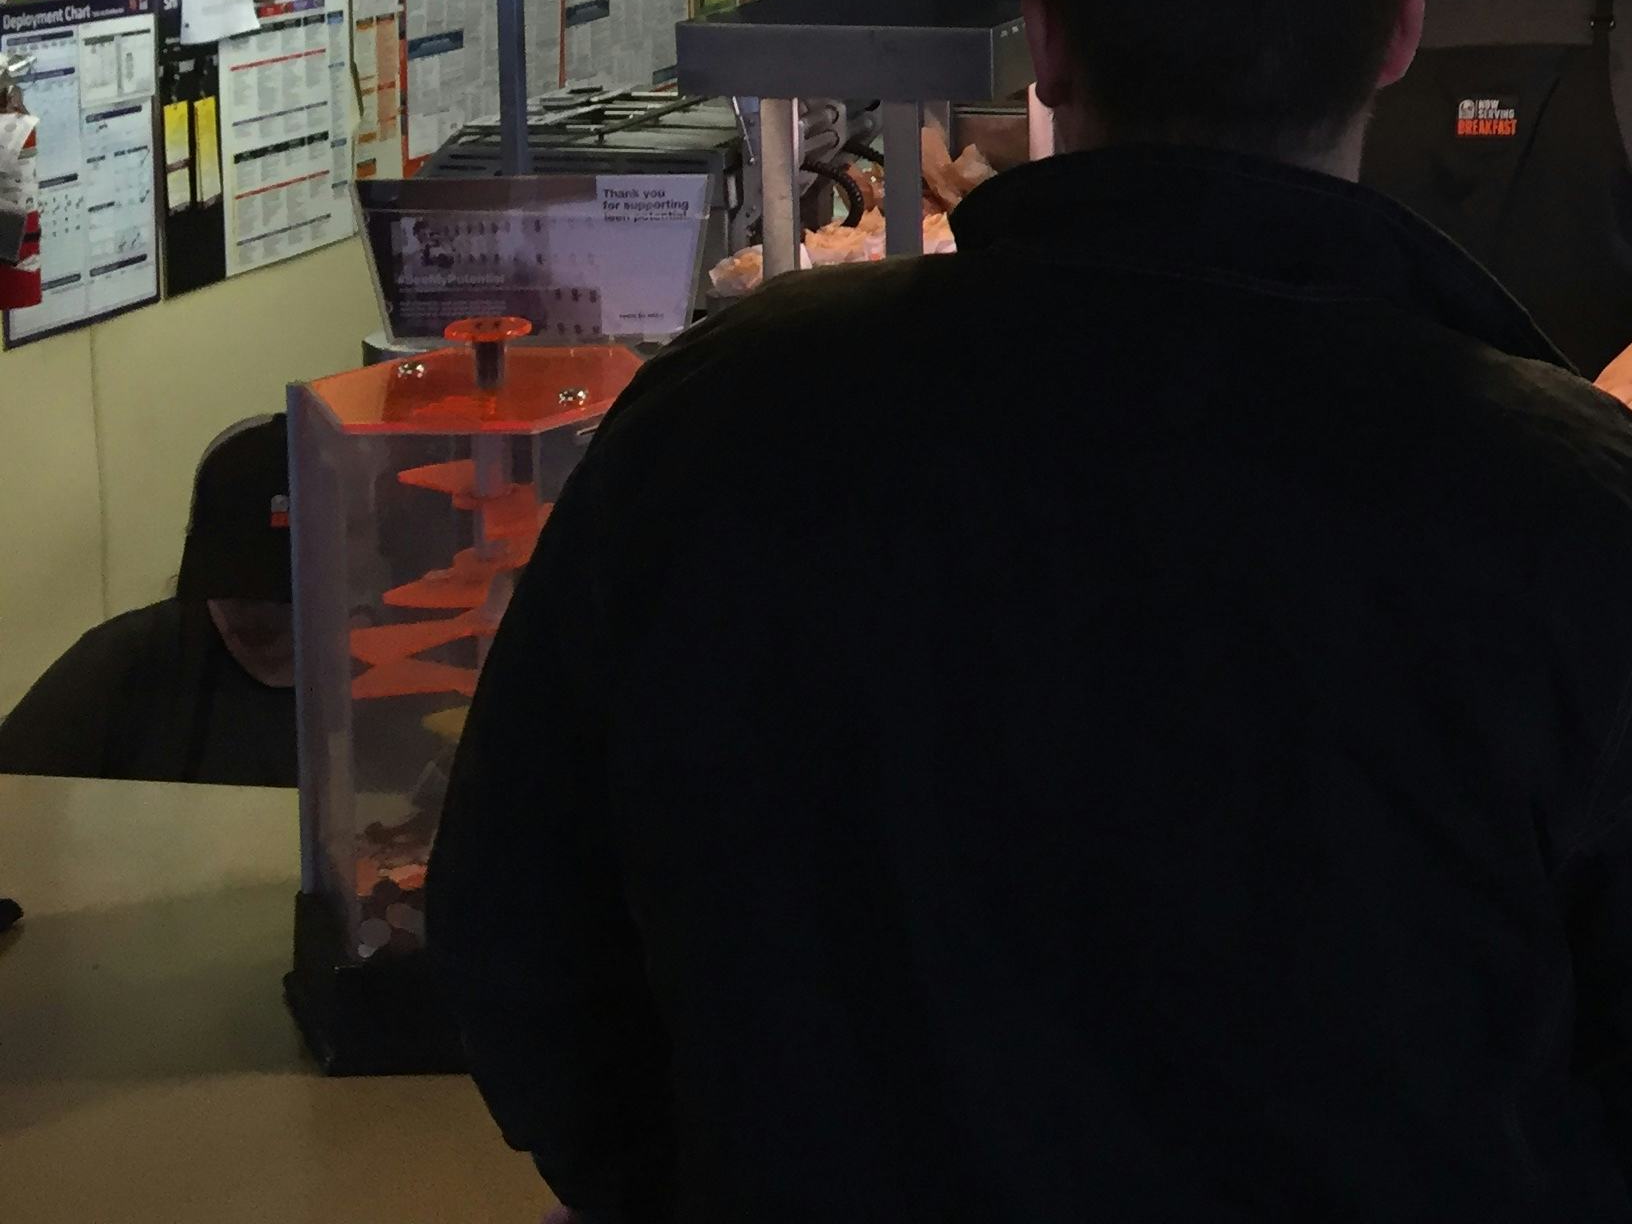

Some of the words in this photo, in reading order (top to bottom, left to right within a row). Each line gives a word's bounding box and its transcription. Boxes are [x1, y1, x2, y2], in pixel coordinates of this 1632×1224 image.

[2, 8, 64, 31] Deployment
[64, 4, 92, 21] Chart
[1478, 100, 1499, 109] NOW
[1478, 109, 1515, 119] SERVING
[1457, 119, 1517, 135] BREAKFAST
[603, 189, 639, 199] Thank
[643, 190, 666, 201] you
[603, 200, 619, 210] for
[623, 200, 689, 215] supporting
